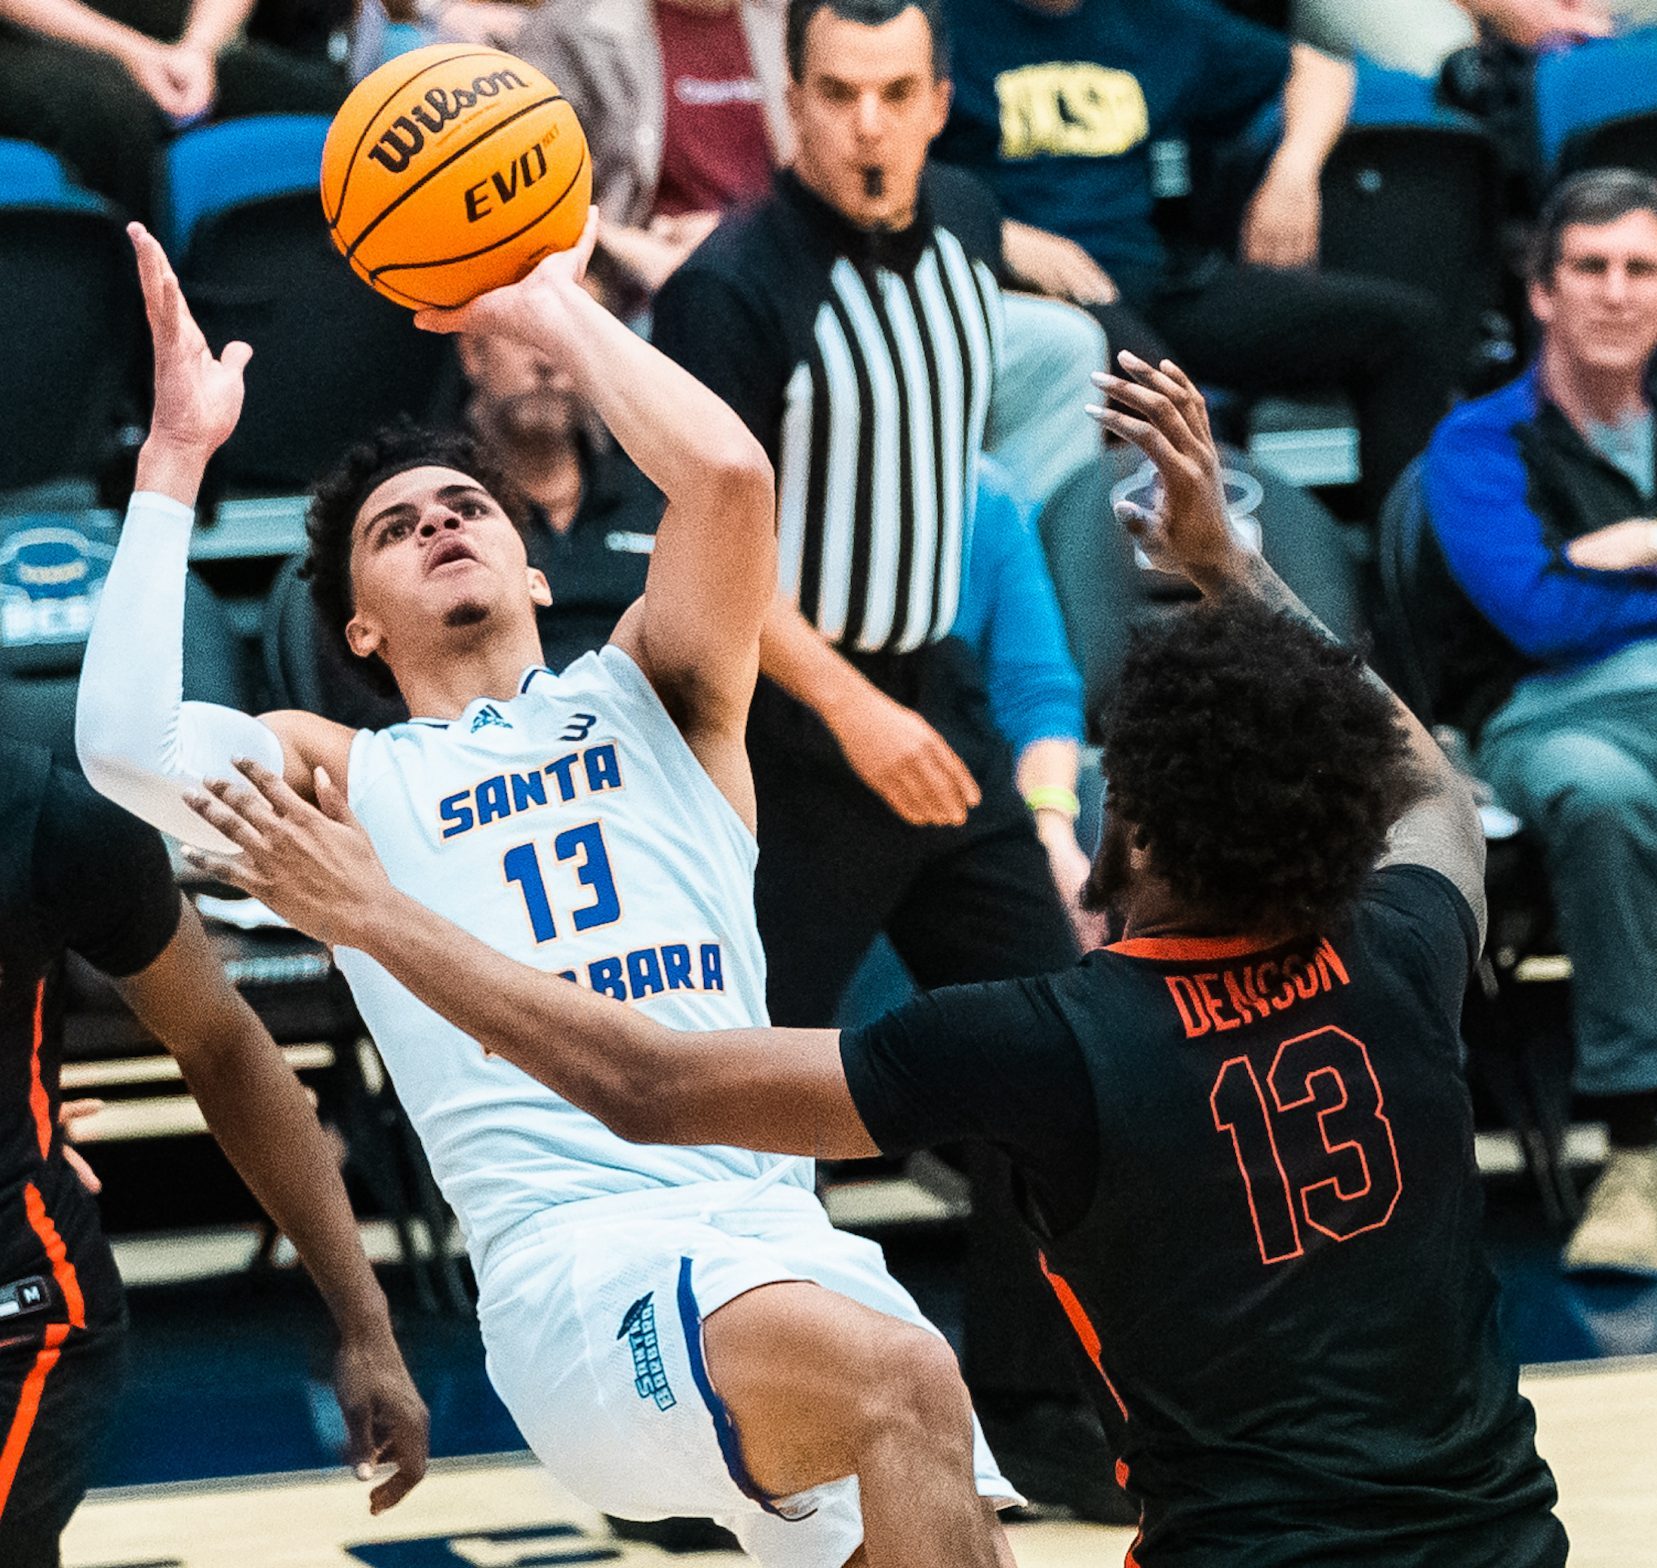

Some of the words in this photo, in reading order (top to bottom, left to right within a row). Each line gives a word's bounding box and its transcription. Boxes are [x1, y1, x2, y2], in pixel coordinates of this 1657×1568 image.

[368, 69, 529, 173] Wilson
[464, 143, 547, 223] EVO
[439, 738, 624, 843] SANTA
[502, 818, 624, 946] 13
[557, 940, 727, 1004] BARA
[1210, 1024, 1402, 1265] 13
